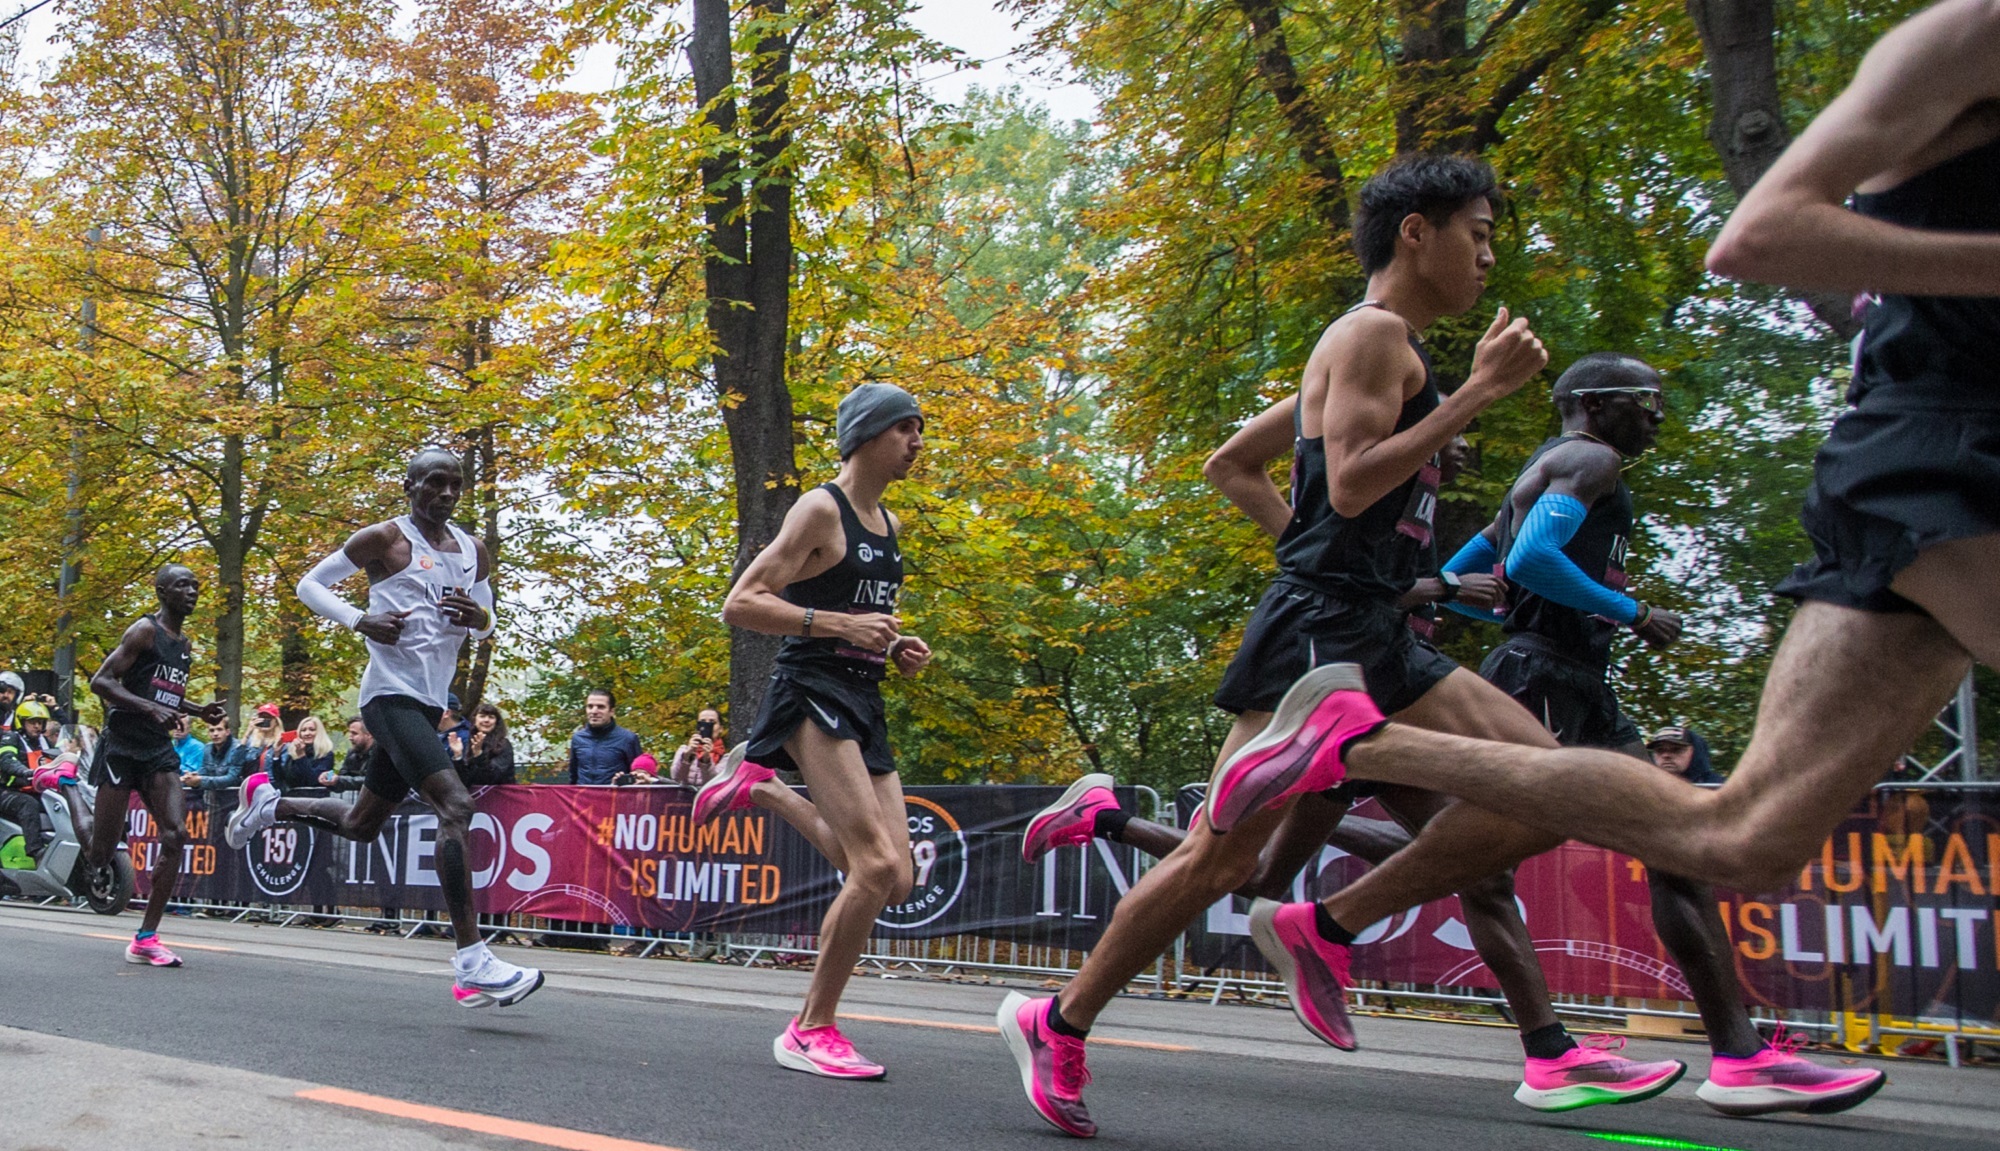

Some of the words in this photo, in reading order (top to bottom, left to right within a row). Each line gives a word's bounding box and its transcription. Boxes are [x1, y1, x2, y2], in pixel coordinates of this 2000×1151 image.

[153, 664, 189, 687] INEOS
[261, 827, 298, 864] 1:59
[345, 811, 554, 892] INEOS
[256, 862, 302, 886] CHALLENGE
